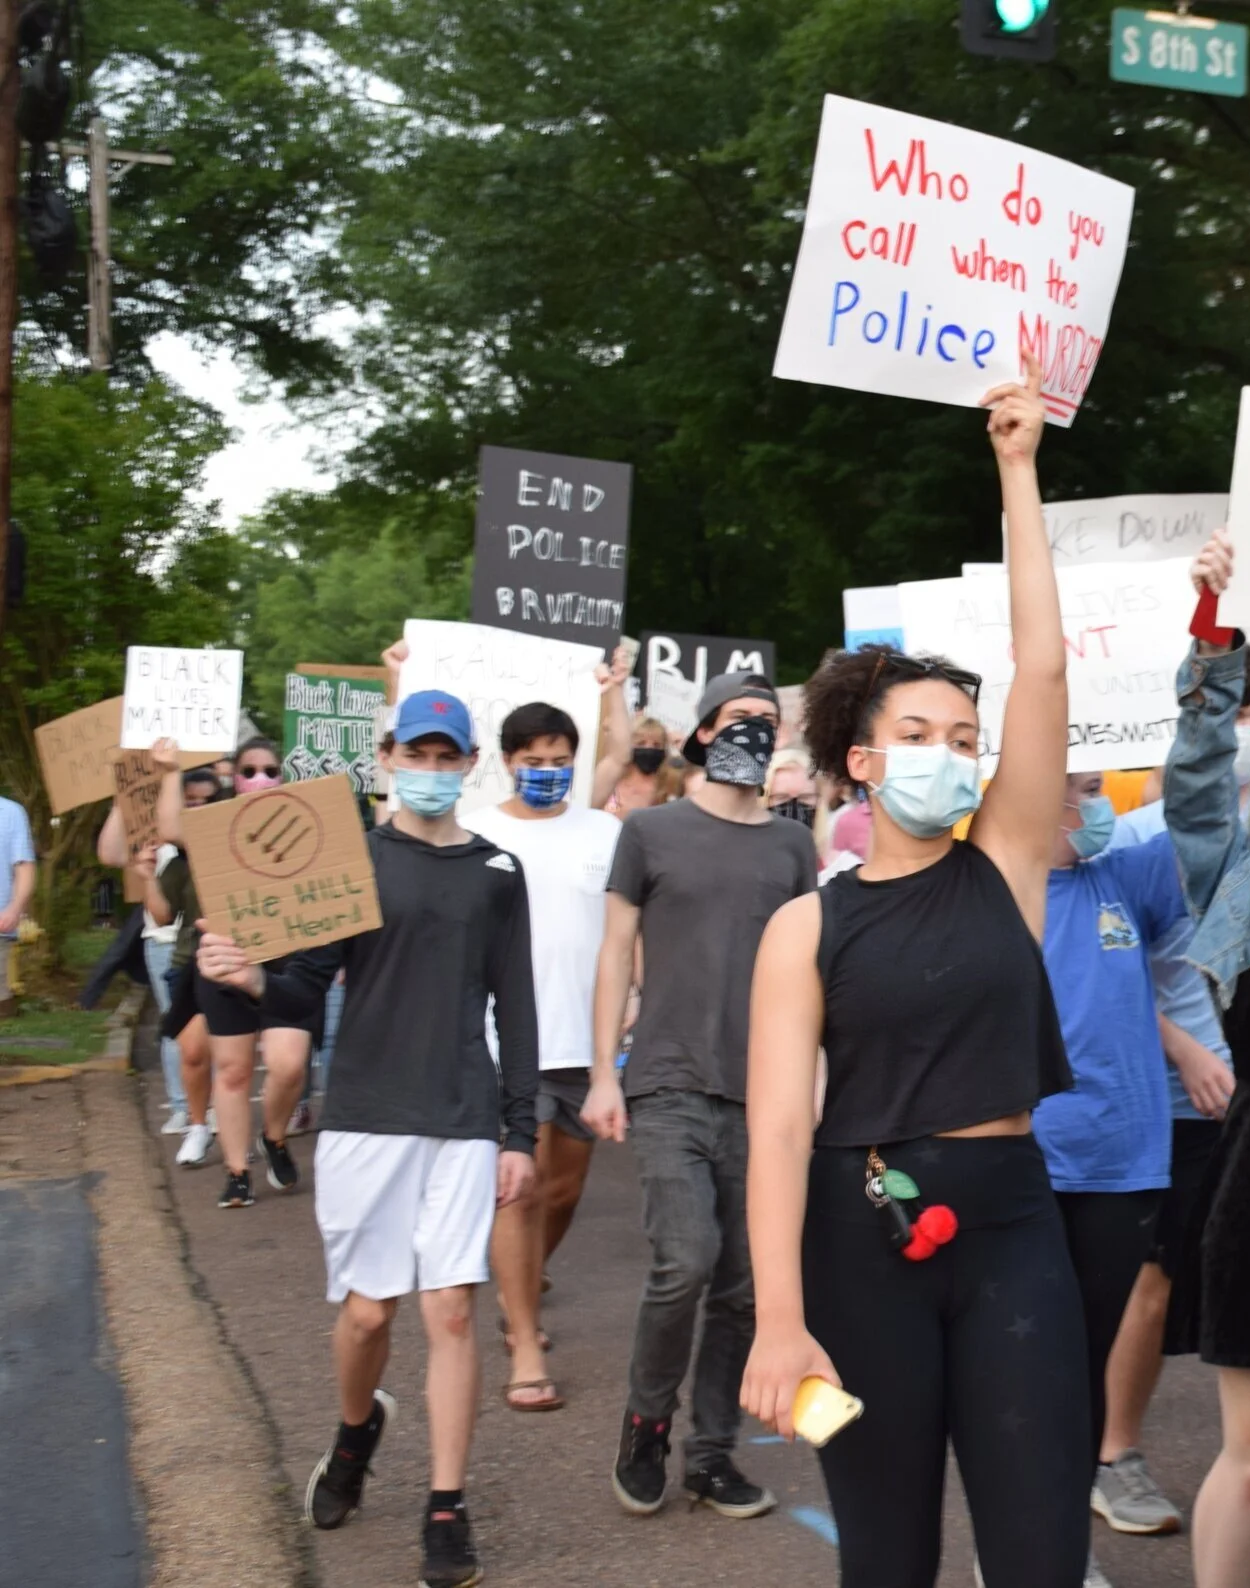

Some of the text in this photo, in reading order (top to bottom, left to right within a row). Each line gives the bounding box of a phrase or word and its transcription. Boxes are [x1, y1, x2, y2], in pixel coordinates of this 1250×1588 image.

[1121, 25, 1237, 78] S 8th St
[864, 127, 1105, 261] Who do you
[950, 238, 1027, 293] when
[1045, 258, 1079, 309] the
[827, 280, 996, 369] Police
[517, 469, 605, 513] END
[507, 523, 627, 569] POLICE
[1052, 516, 1099, 559] KE
[1062, 584, 1162, 619] IVES
[138, 652, 233, 685] BLACK
[154, 686, 211, 706] LIVES
[127, 706, 231, 736] MATTER
[297, 716, 375, 753] MATTE
[225, 873, 364, 922] We WILL
[284, 903, 363, 942] Heard
